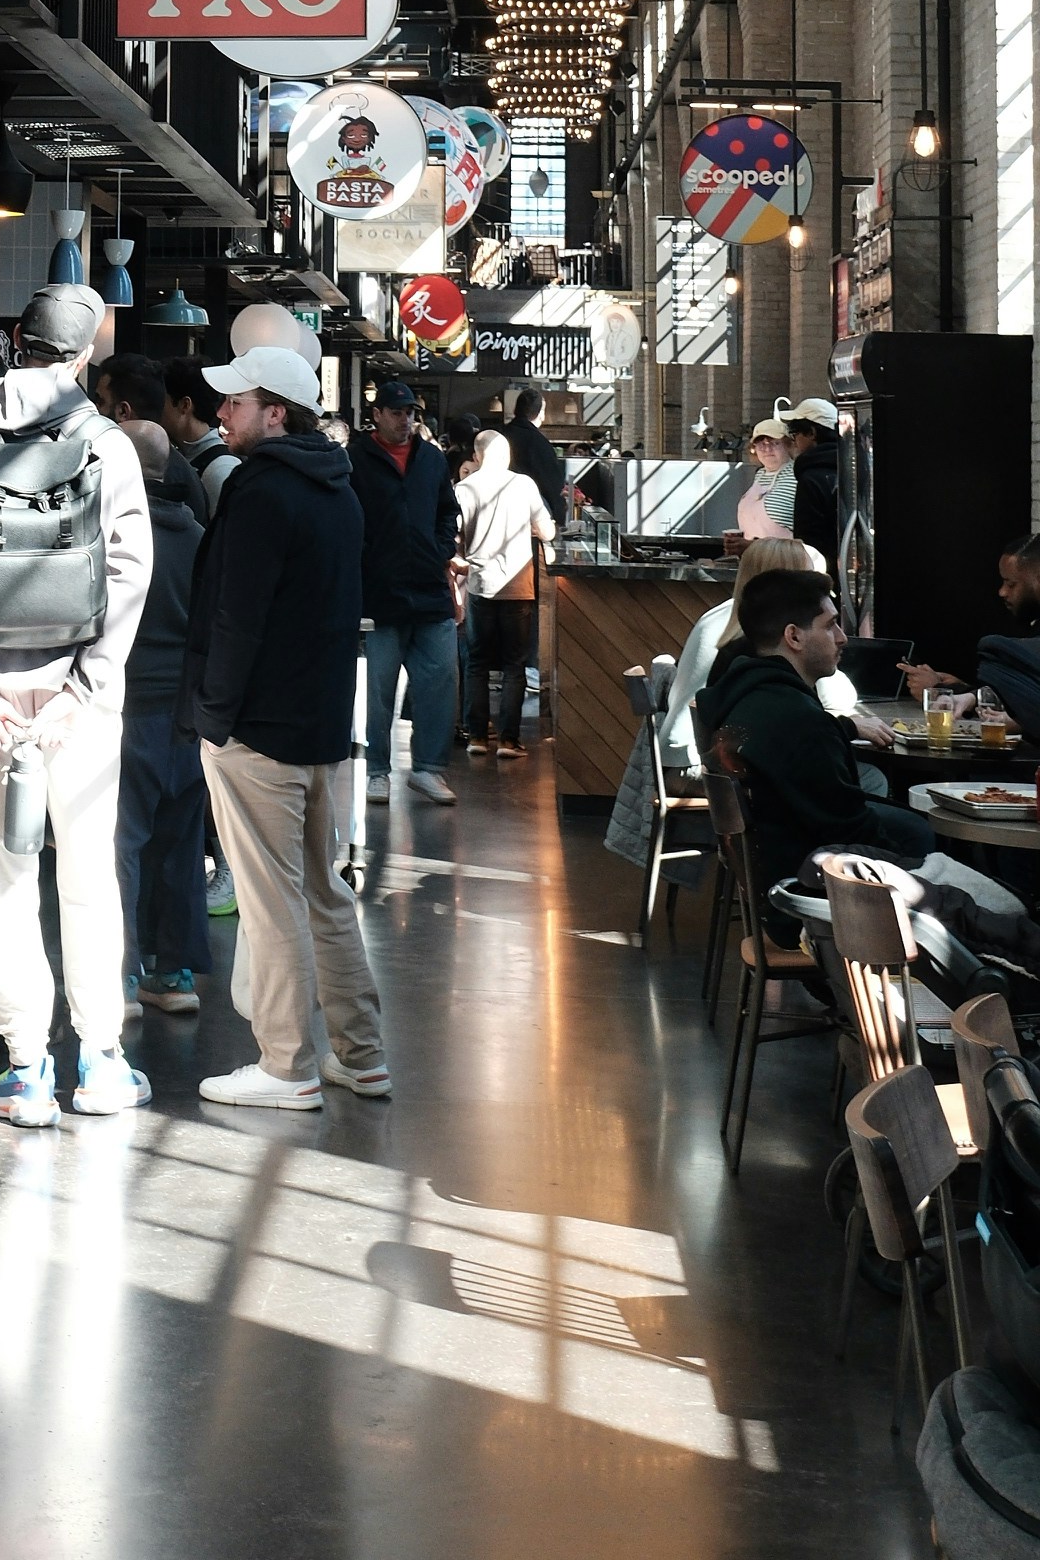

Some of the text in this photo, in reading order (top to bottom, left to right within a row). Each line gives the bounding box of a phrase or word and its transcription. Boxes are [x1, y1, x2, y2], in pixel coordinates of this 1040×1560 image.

[685, 164, 790, 190] scooped
[326, 181, 385, 194] RASTA
[326, 192, 385, 204] PASTA
[355, 228, 428, 240] SOCIAL
[407, 290, 448, 327] 炙
